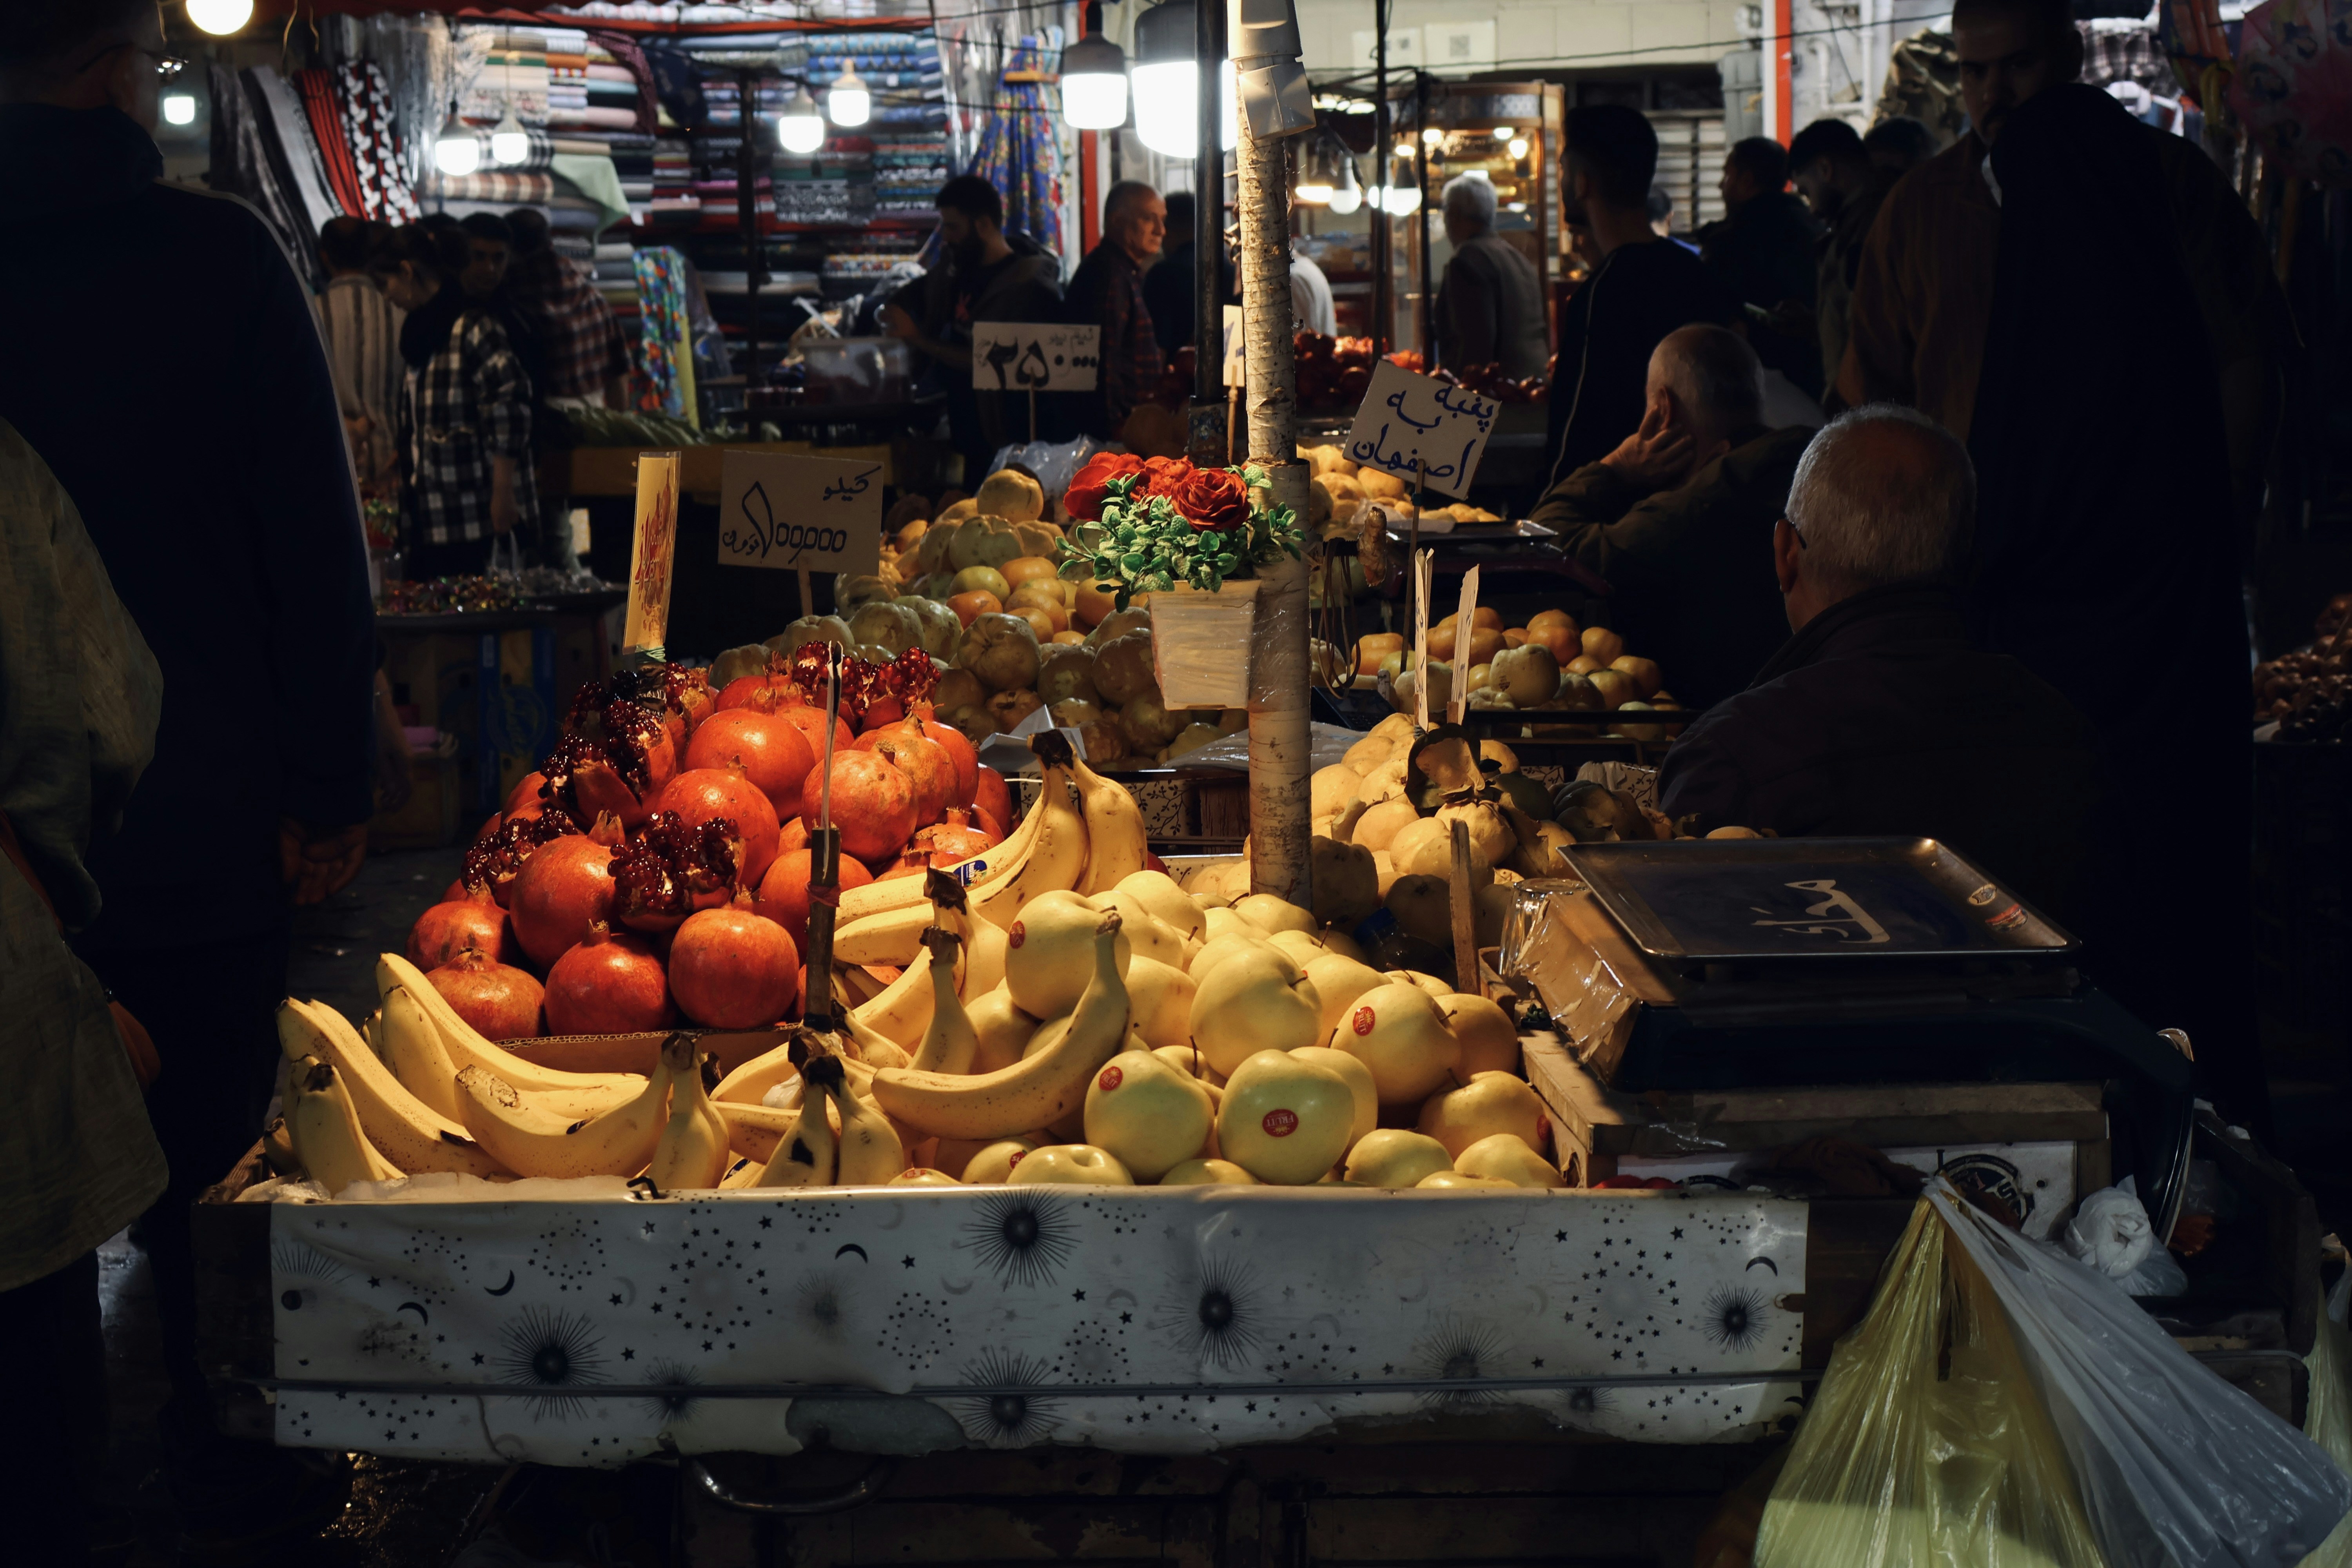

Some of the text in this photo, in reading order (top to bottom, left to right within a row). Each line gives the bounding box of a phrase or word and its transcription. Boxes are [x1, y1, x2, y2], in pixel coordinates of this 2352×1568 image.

[1387, 390, 1442, 434] به
[1353, 423, 1477, 490] اصفهان
[823, 465, 882, 501] کیلو
[1265, 1114, 1294, 1127] FRUIT
